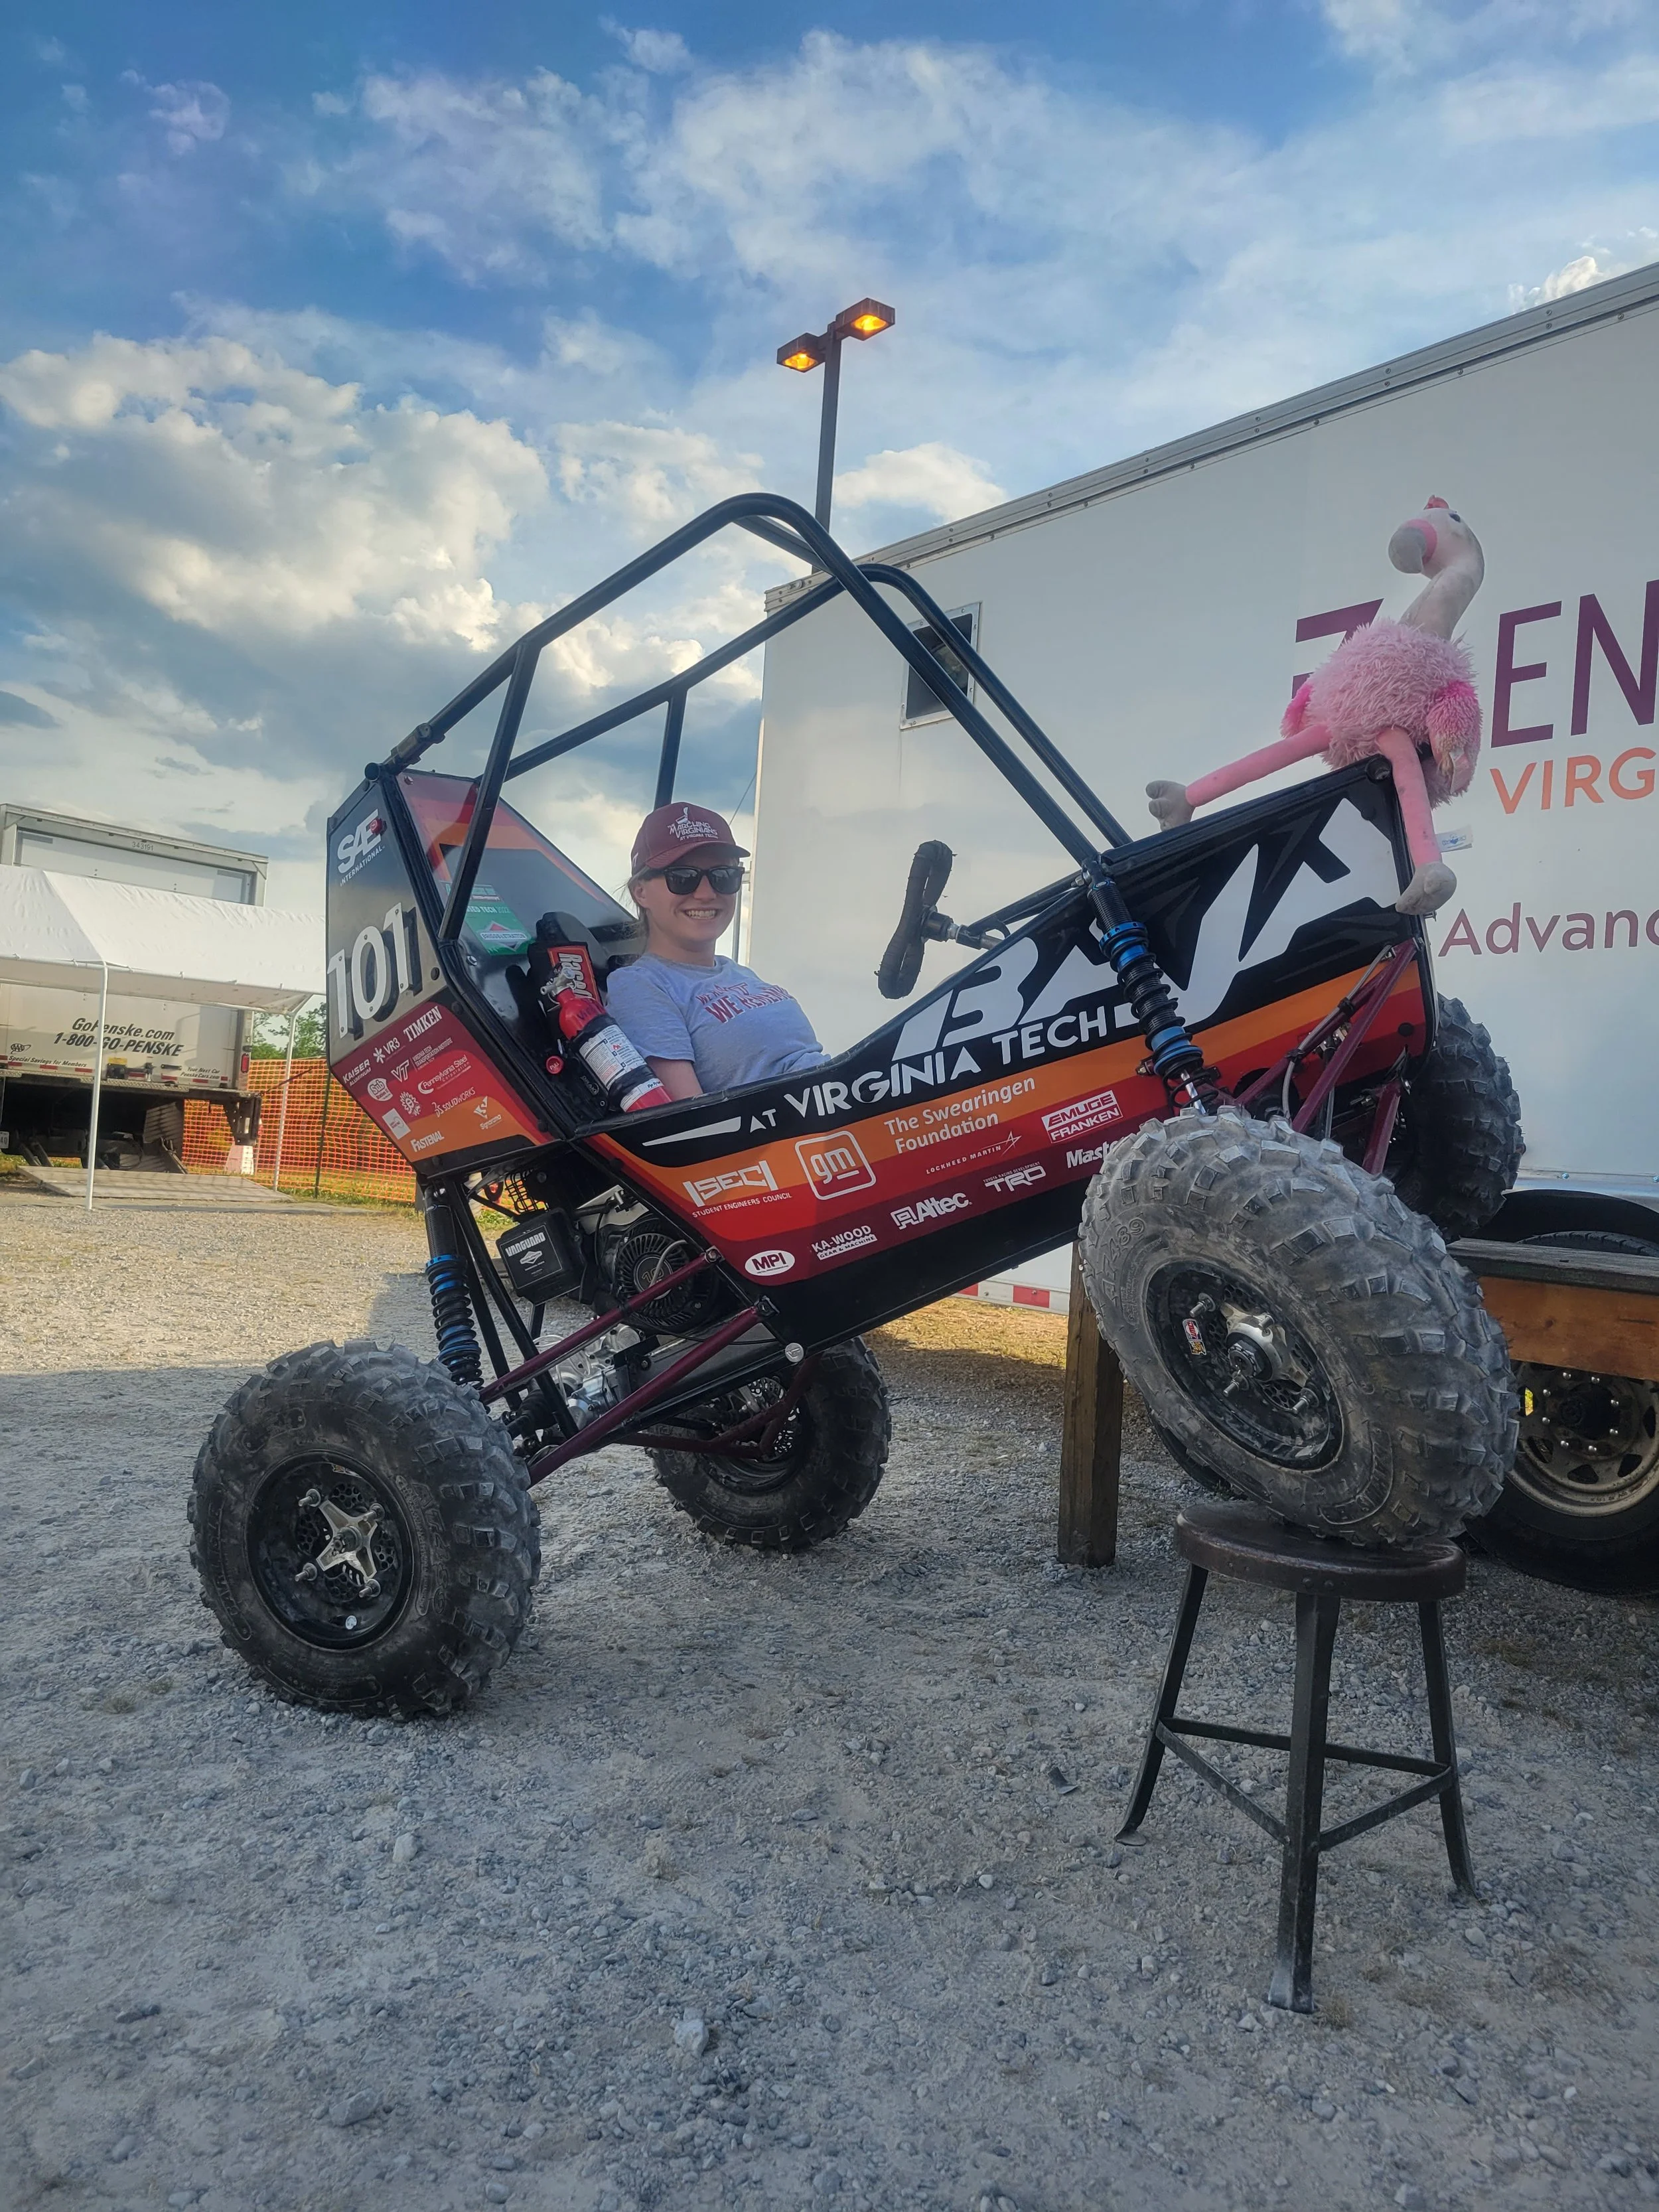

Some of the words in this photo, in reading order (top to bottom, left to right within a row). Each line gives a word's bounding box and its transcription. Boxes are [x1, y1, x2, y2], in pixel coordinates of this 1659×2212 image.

[1490, 747, 1657, 815] VIRG
[327, 902, 409, 1039] 101
[403, 1005, 443, 1043] TIMKEN
[705, 995, 745, 1024] WE
[383, 1037, 401, 1055] VR3
[342, 1059, 370, 1084] KAISER
[423, 1064, 455, 1089] Pennsylvania
[453, 1055, 468, 1069] Steel
[750, 1108, 777, 1134] AT
[784, 1046, 981, 1118] VIRGINIA
[992, 1005, 1108, 1065] TECH
[442, 1086, 476, 1112] SOLIDWORKS
[884, 1116, 920, 1136] The
[922, 1076, 1036, 1126] Swearingen
[1048, 1093, 1115, 1128] EMUGE
[895, 1112, 999, 1154] Foundation
[1050, 1108, 1120, 1141] FRANKEN
[411, 1130, 445, 1153] FASTENAL
[810, 1147, 856, 1185] gm
[926, 1157, 967, 1175] LOCKHEED
[970, 1145, 1002, 1160] MARTIN
[984, 1165, 1046, 1193] TRD
[692, 1205, 723, 1218] STUDENT
[724, 1198, 760, 1211] ENGINEERS
[762, 1192, 792, 1203] COUNCIL
[505, 1232, 546, 1258] VANGUARD
[811, 1225, 871, 1253] KA-WOOD
[820, 1250, 837, 1258] GEAR
[845, 1236, 875, 1248] MACHINE
[751, 1252, 787, 1271] MPI
